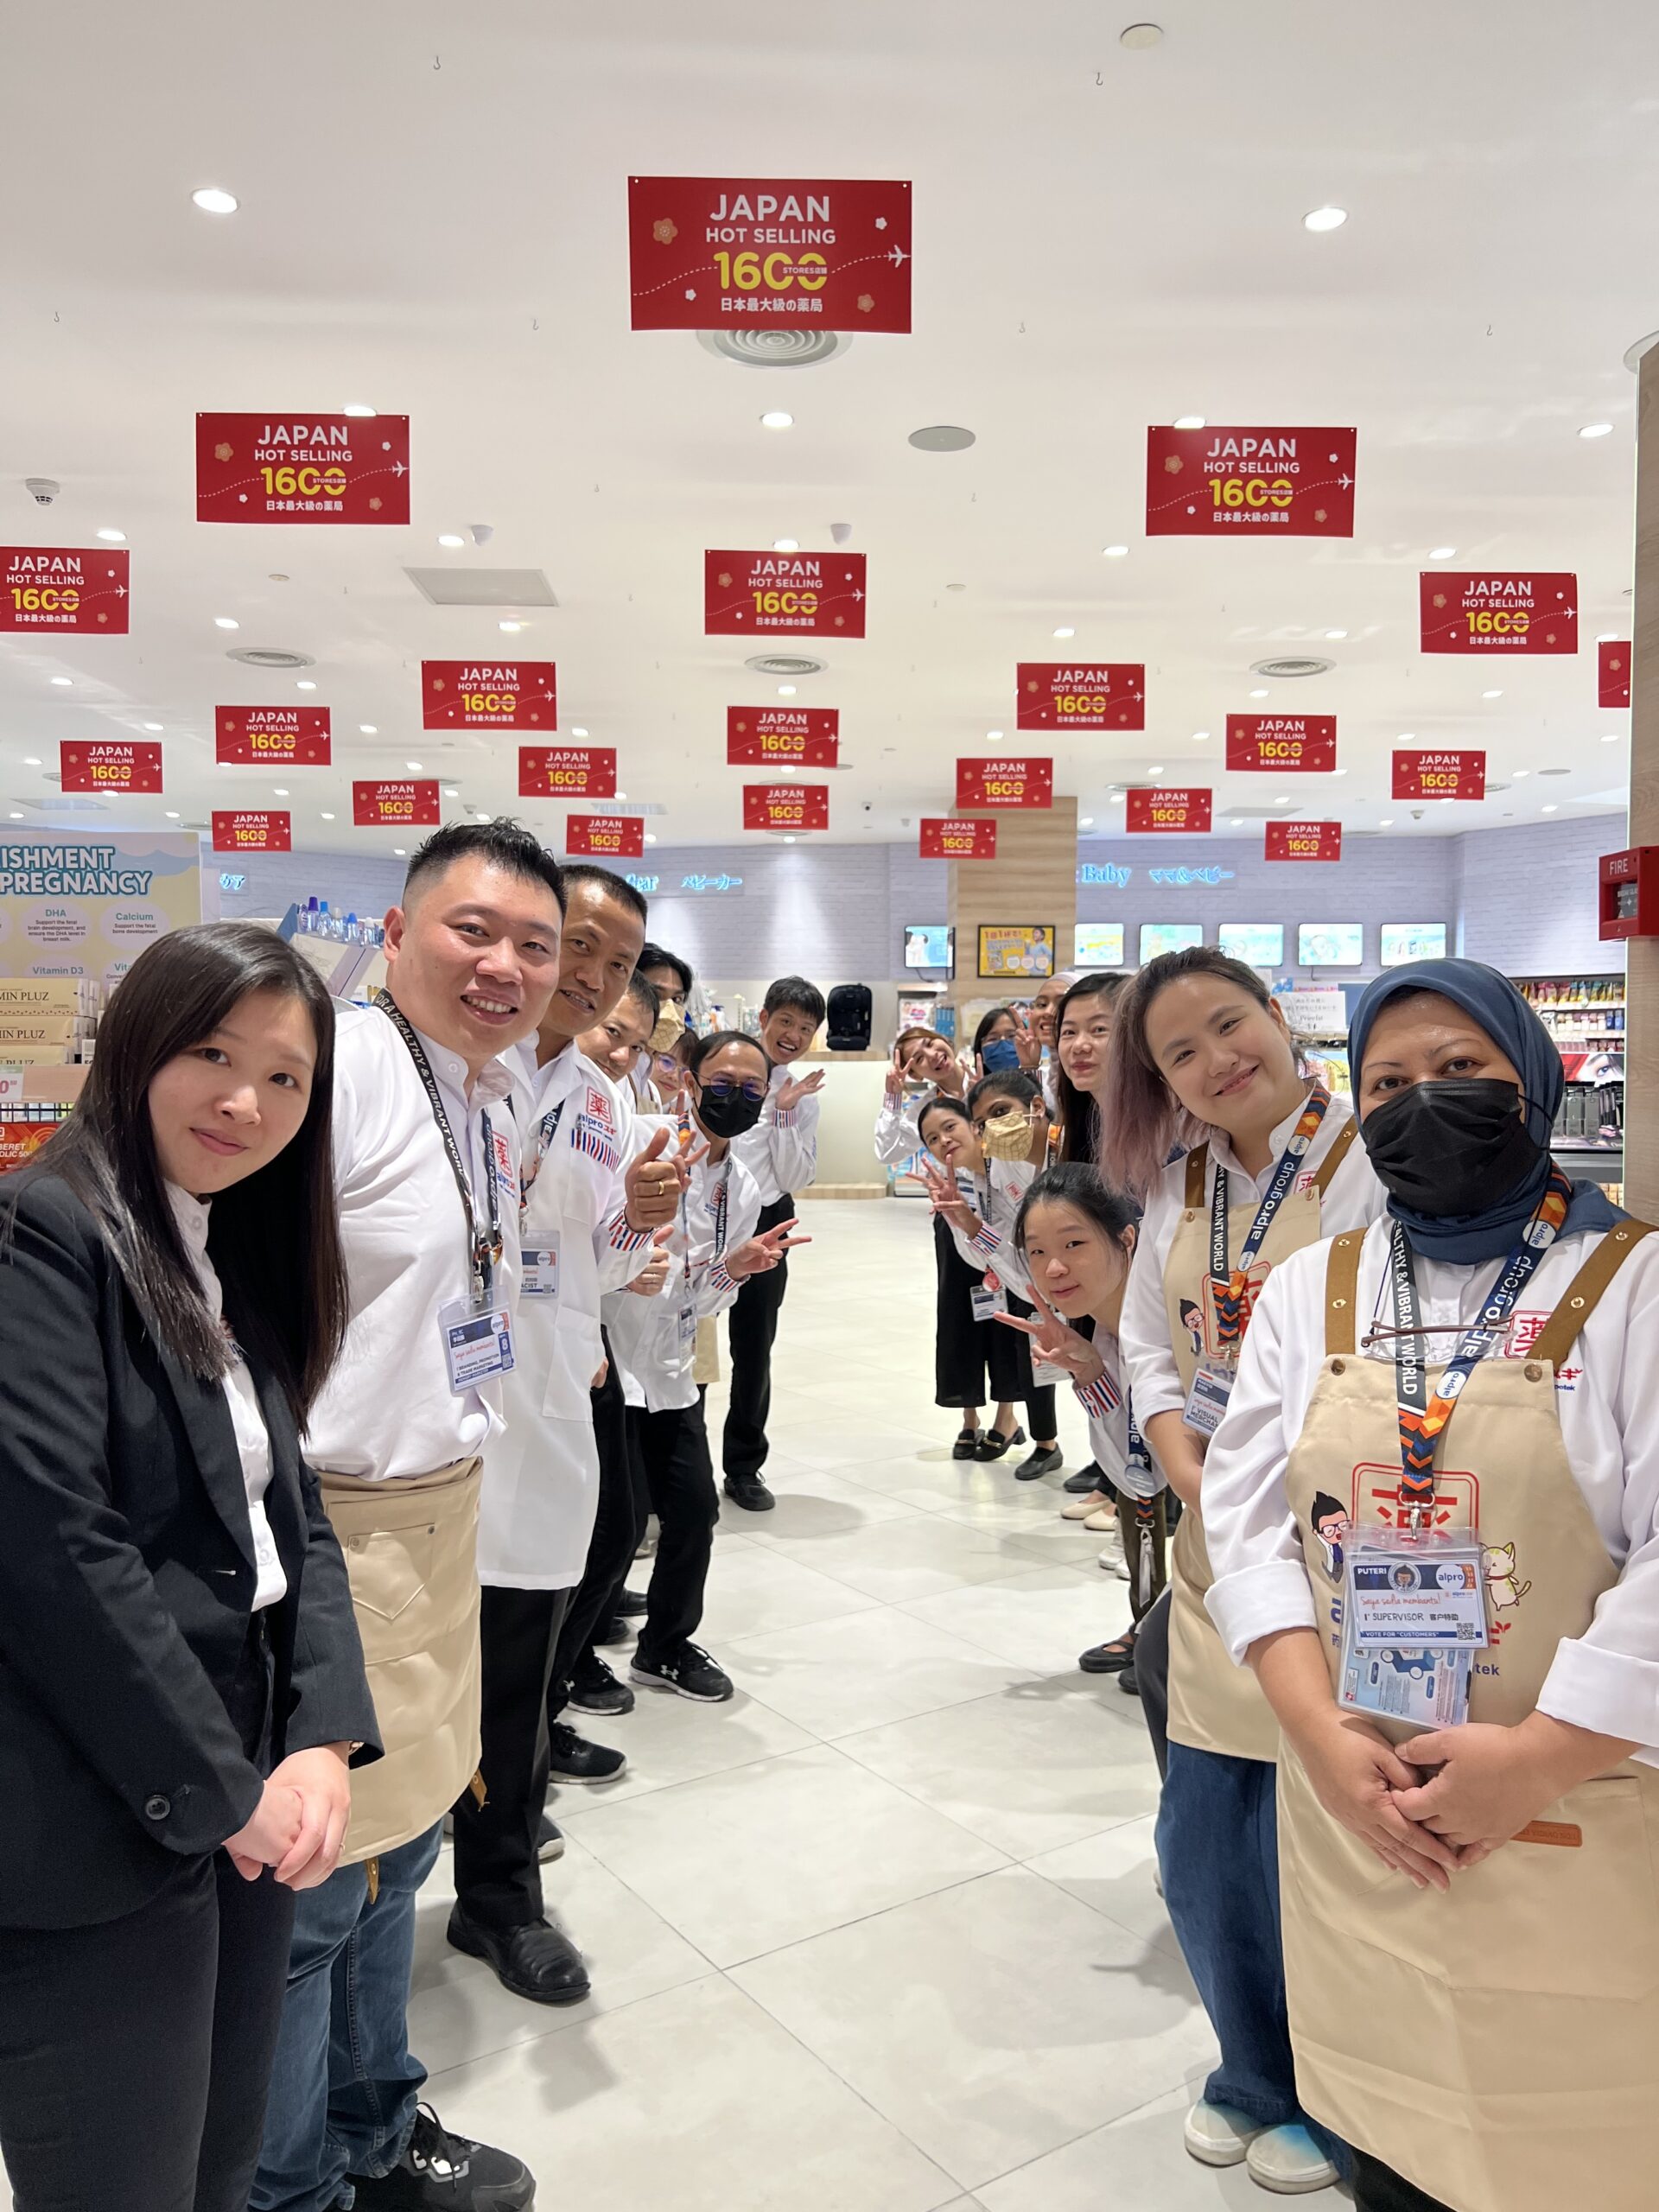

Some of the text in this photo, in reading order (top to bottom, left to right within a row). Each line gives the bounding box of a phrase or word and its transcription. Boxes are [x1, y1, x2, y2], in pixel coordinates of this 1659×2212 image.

[710, 194, 830, 222] JAPAN
[706, 227, 836, 244] HOT SELLING
[714, 251, 827, 290] 1600
[721, 297, 823, 312] 日本最大級の薬局
[257, 425, 347, 446] JAPAN
[1207, 437, 1296, 457] JAPAN
[255, 449, 353, 461] HOT SELLING
[1204, 461, 1300, 474] HOT SELLING
[260, 467, 346, 496] 1600
[1209, 479, 1293, 507] 1600
[266, 500, 343, 512] 日本最大級の薬局
[1213, 512, 1289, 523] 日本最大級の薬局
[9, 556, 80, 573] JAPAN
[751, 560, 819, 576] JAPAN
[7, 575, 85, 585] HOT SELLING
[748, 578, 823, 588] HOT SELLING
[1465, 581, 1531, 595] JAPAN
[11, 588, 79, 611] 1600
[753, 591, 817, 614] 1600
[1462, 599, 1535, 607] HOT SELLING
[15, 613, 77, 623] 日本最大級の薬局
[1465, 612, 1529, 632] 1600
[460, 668, 517, 681] JAPAN
[1053, 671, 1108, 683] JAPAN
[481, 683, 520, 691] SELLING
[461, 694, 516, 712] 1600
[1054, 696, 1106, 713] 1600
[248, 712, 297, 723] JAPAN
[759, 713, 807, 725] JAPAN
[1257, 720, 1305, 731] JAPAN
[250, 734, 296, 749] 1600
[760, 735, 805, 751] 1600
[89, 747, 132, 756] JAPAN
[1258, 741, 1302, 757] 1600
[547, 752, 588, 762] JAPAN
[1420, 755, 1459, 765] JAPAN
[91, 766, 131, 779] 1600
[983, 763, 1026, 772] JAPAN
[548, 771, 588, 785] 1600
[1420, 773, 1459, 787] 1600
[377, 785, 414, 794] JAPAN
[767, 790, 804, 798] JAPAN
[984, 782, 1024, 795] 1600
[1151, 792, 1188, 802] JAPAN
[378, 802, 413, 814] 1600
[768, 806, 804, 818] 1600
[1152, 809, 1186, 821] 1600
[588, 819, 622, 829] JAPAN
[235, 830, 267, 841] 1600
[589, 835, 620, 847] 1600
[943, 837, 974, 849] 1600
[1288, 840, 1319, 851] 1600
[1609, 858, 1629, 876] FIRE
[1082, 862, 1131, 887] Baby
[0, 872, 151, 893] PREGNANCY
[116, 912, 154, 921] Calcium
[33, 966, 69, 975] Vitamin
[21, 991, 49, 1001] PLUZ
[16, 1029, 46, 1039] PLUZ
[391, 1012, 426, 1065] HEALTHY
[421, 1067, 430, 1077] &
[426, 1080, 451, 1135] VIBRANT
[580, 1113, 603, 1129] alpro
[1294, 1135, 1306, 1154] alpro
[1213, 1179, 1225, 1272] & VIBRANT WORLD
[1531, 1224, 1548, 1245] alpro
[1241, 1251, 1252, 1270] alpro
[1396, 1272, 1408, 1282] &
[1402, 1343, 1418, 1395] WORLD
[1443, 1372, 1459, 1396] alpro
[1197, 1408, 1218, 1423] VISUAL
[1438, 1573, 1464, 1583] alpro
[1360, 1596, 1379, 1610] Saya
[1402, 1592, 1441, 1605] membantu!
[1372, 1612, 1425, 1622] SUPERVISOR
